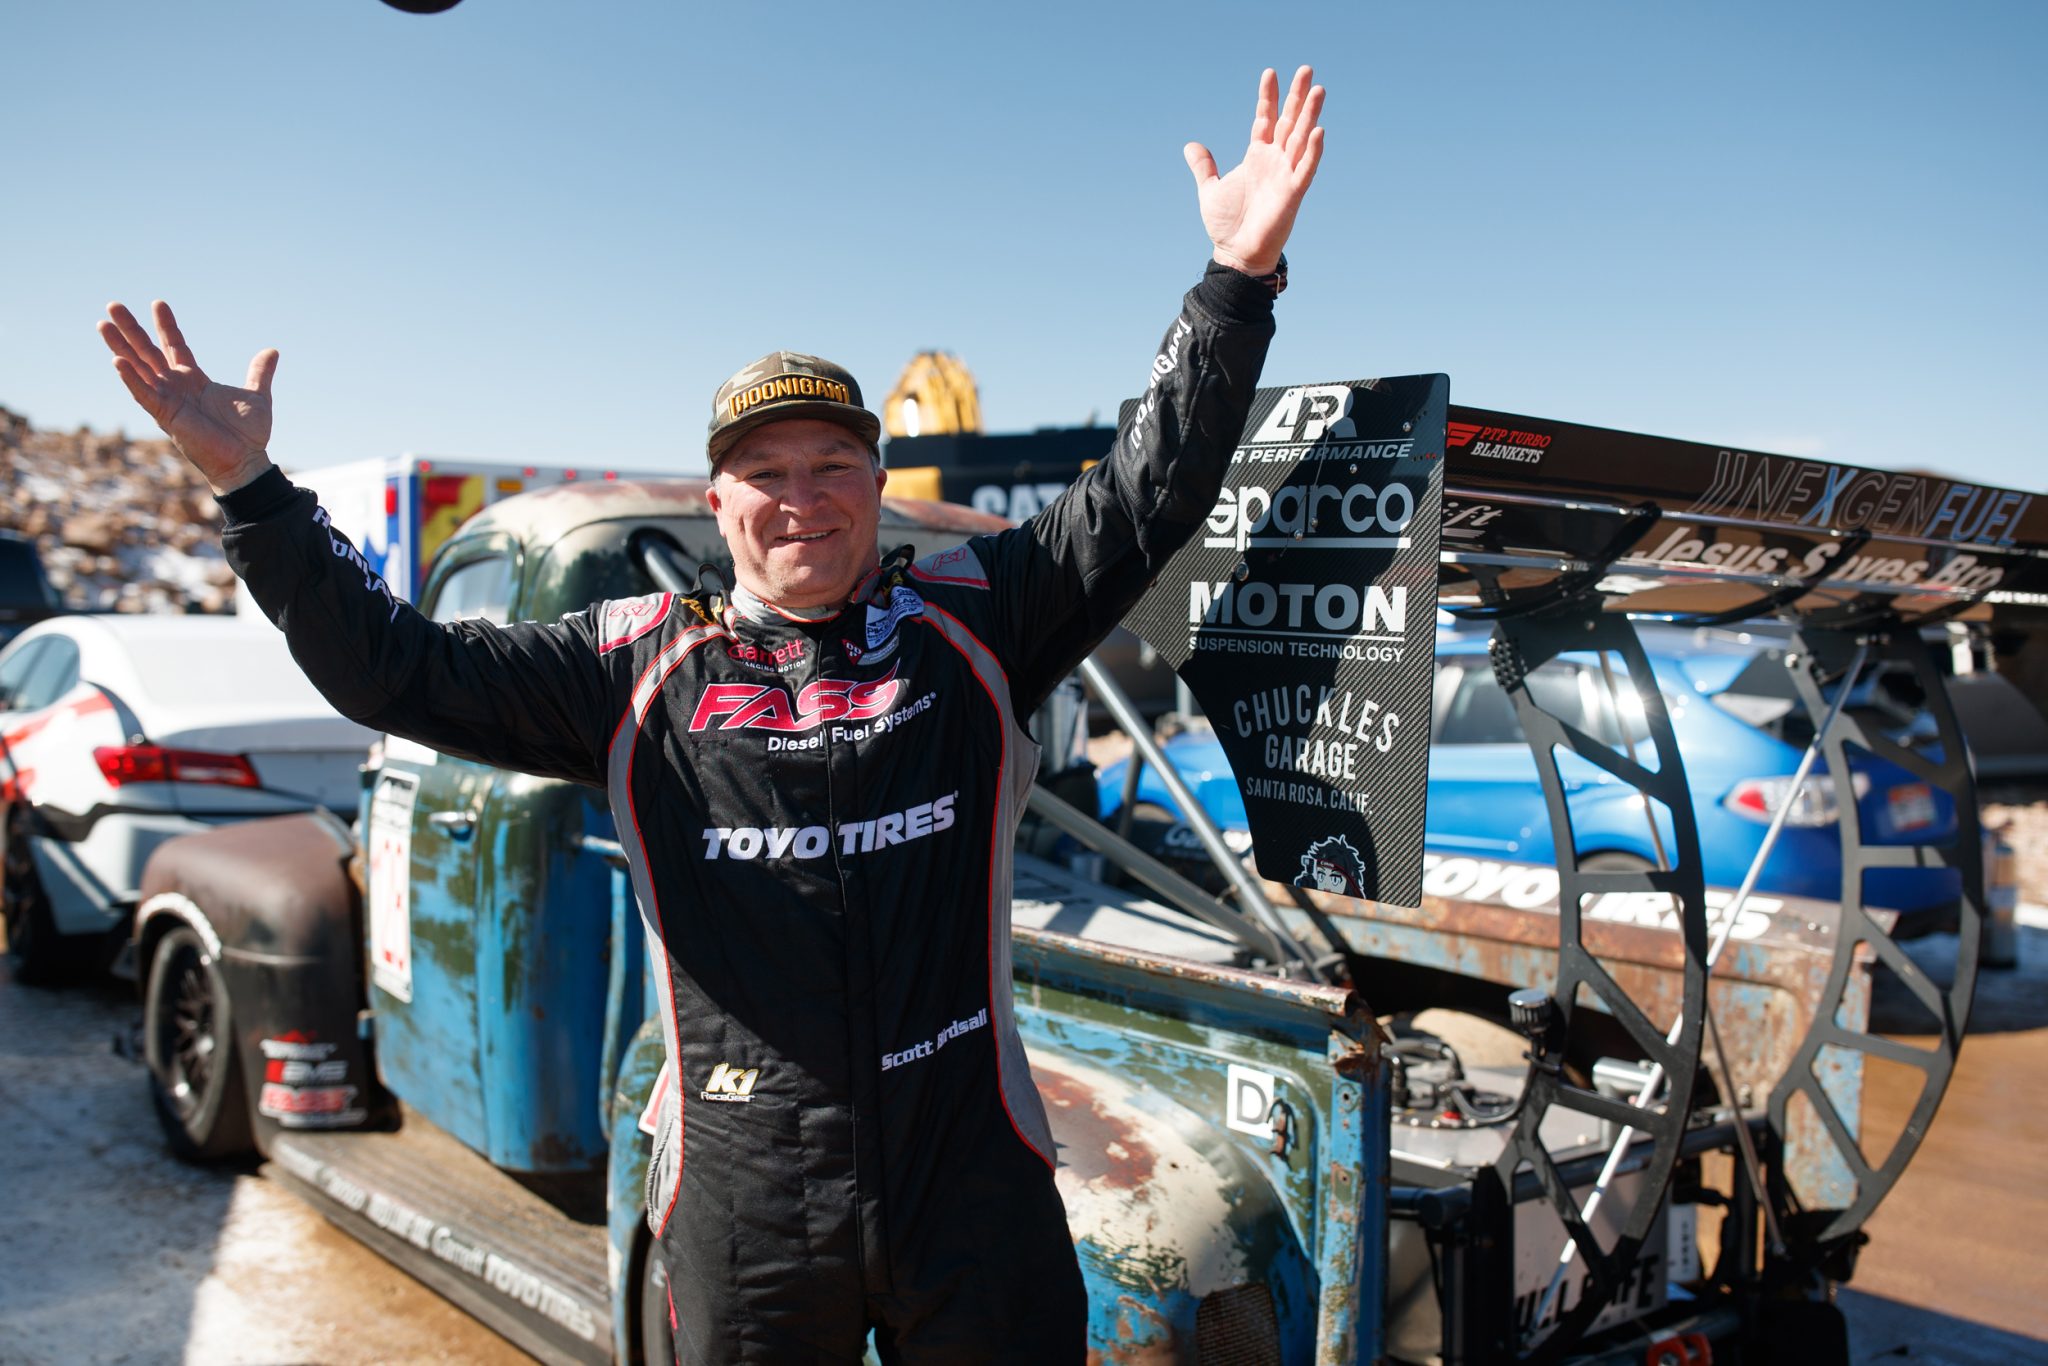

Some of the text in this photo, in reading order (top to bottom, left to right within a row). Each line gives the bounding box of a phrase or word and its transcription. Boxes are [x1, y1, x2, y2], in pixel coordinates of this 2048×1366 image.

[1248, 444, 1414, 463] PERFORMANCE
[1471, 442, 1544, 463] BLANKETS
[1480, 427, 1552, 448] PTP TURBO
[1206, 482, 1414, 551] sparco
[1631, 527, 1789, 575] Jesus
[1927, 554, 2004, 589] Bro
[1189, 581, 1408, 632] MOTON
[727, 638, 805, 664] Garrett
[777, 659, 806, 673] MOTION
[1189, 636, 1406, 663] SUSPENSION TECHNOLOGY
[688, 658, 900, 732] FASS
[1233, 684, 1400, 753] CHUCKLES
[767, 729, 825, 751] Diesel
[831, 723, 869, 745] Fuel
[1264, 733, 1358, 780] GARAGE
[1246, 776, 1373, 815] SANTA ROSA, CALIF.
[702, 825, 831, 860] TOYO
[881, 1040, 934, 1072] Scott
[1237, 1078, 1268, 1125] D
